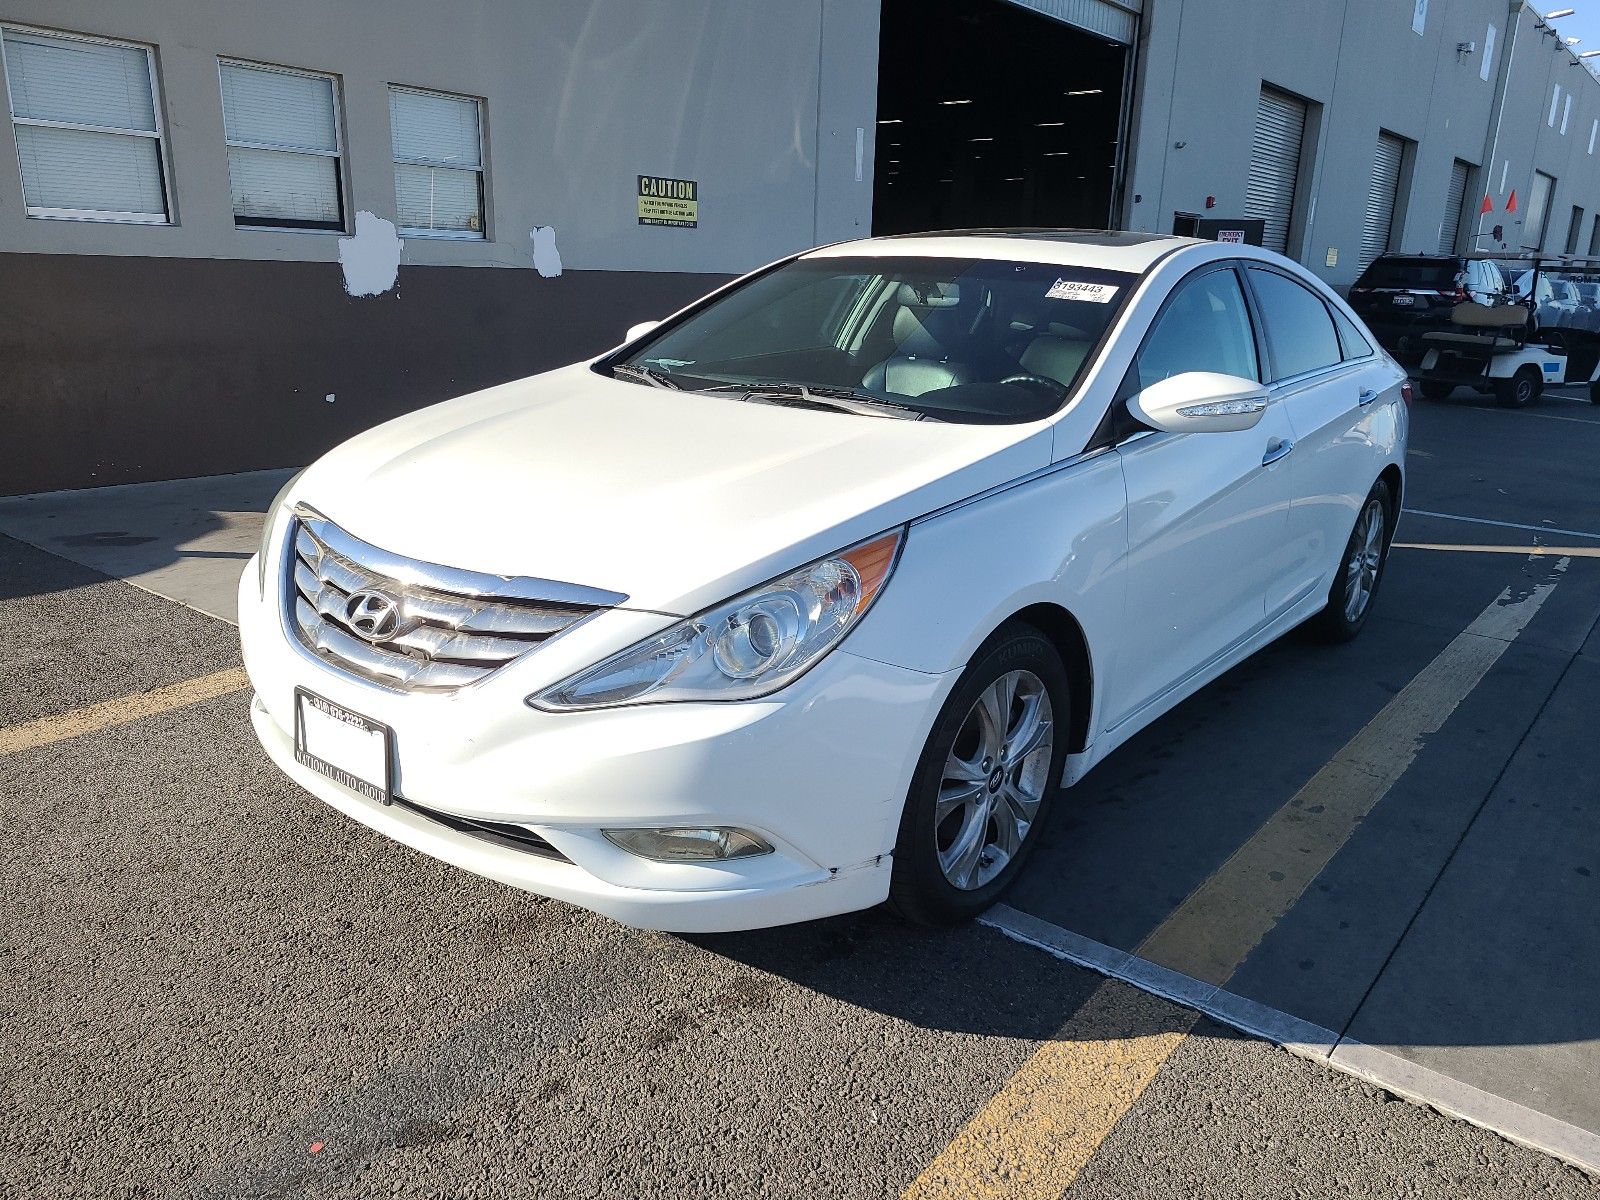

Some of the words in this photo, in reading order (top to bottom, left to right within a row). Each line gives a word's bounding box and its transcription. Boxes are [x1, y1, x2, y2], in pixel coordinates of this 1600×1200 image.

[641, 177, 693, 199] CAUTION
[296, 750, 335, 782] NATIONAL
[335, 770, 357, 790] AUTO
[358, 781, 386, 804] GROUP
